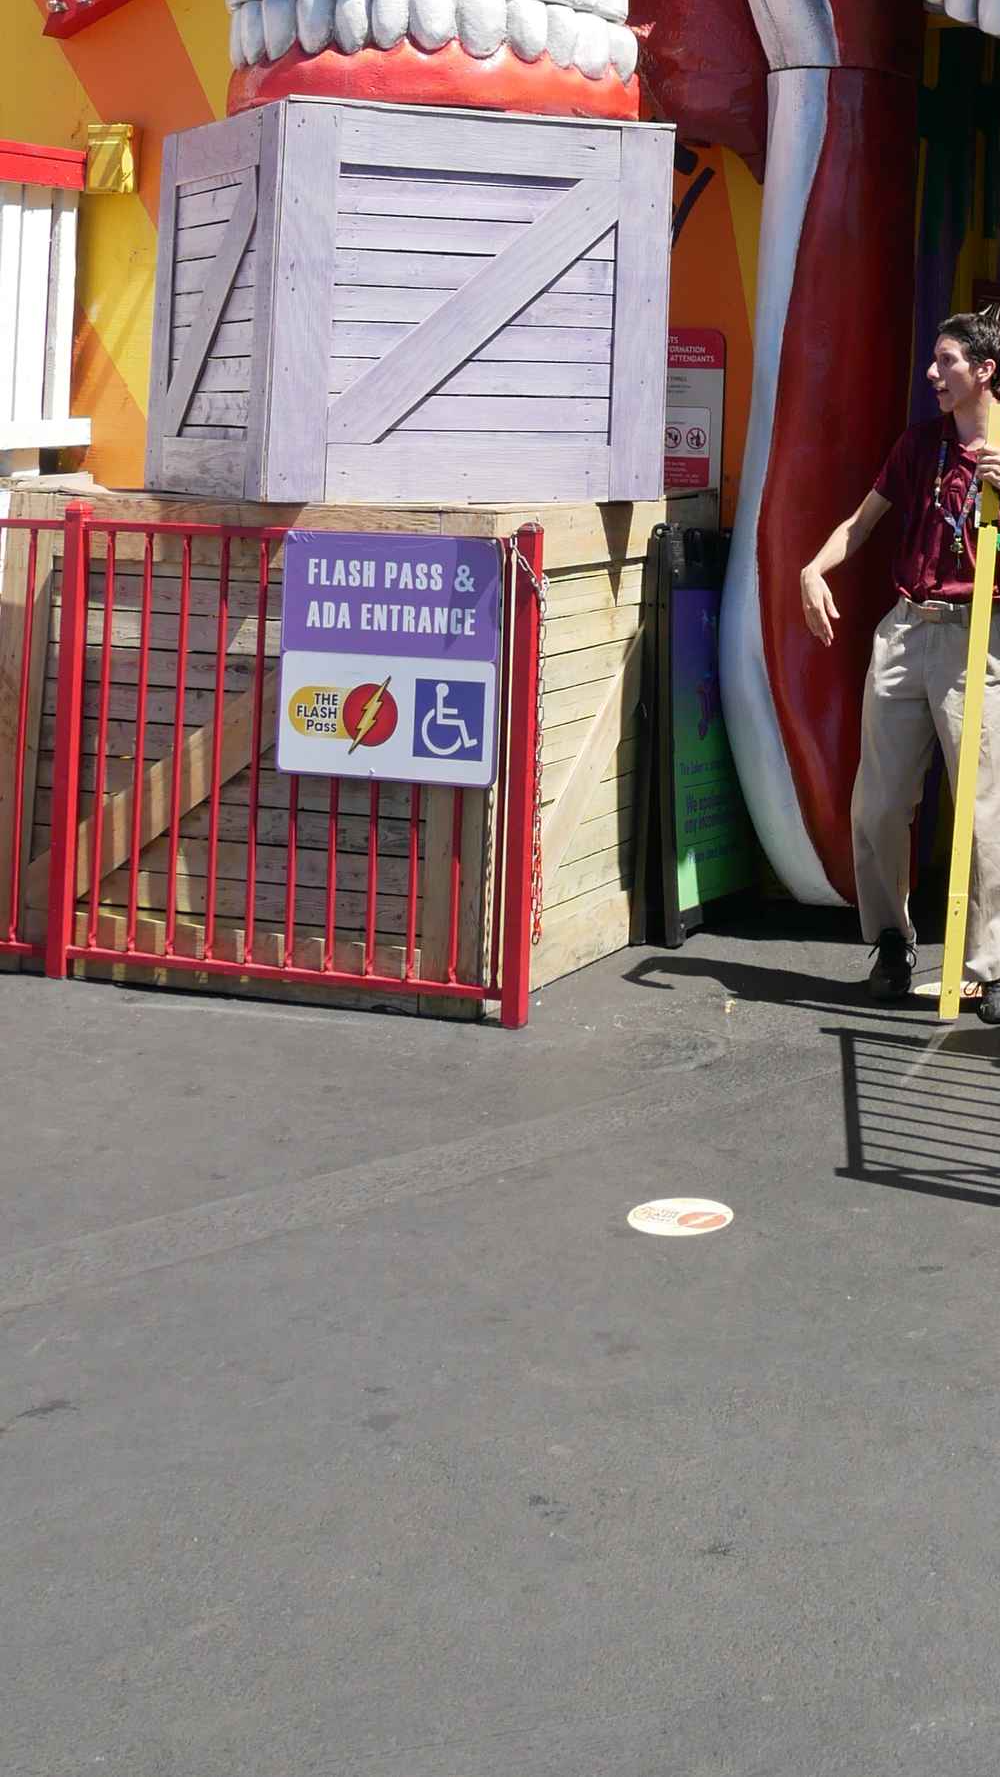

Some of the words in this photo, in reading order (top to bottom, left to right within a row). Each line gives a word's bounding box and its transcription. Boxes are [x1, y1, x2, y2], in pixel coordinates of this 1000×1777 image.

[308, 558, 376, 588] FLASH
[384, 561, 443, 591] PASS
[454, 564, 476, 593] &
[306, 600, 352, 630] ADA
[360, 603, 476, 637] ENTRANCE
[314, 692, 339, 707] THE
[296, 705, 338, 720] FLASH
[306, 719, 337, 733] Pass
